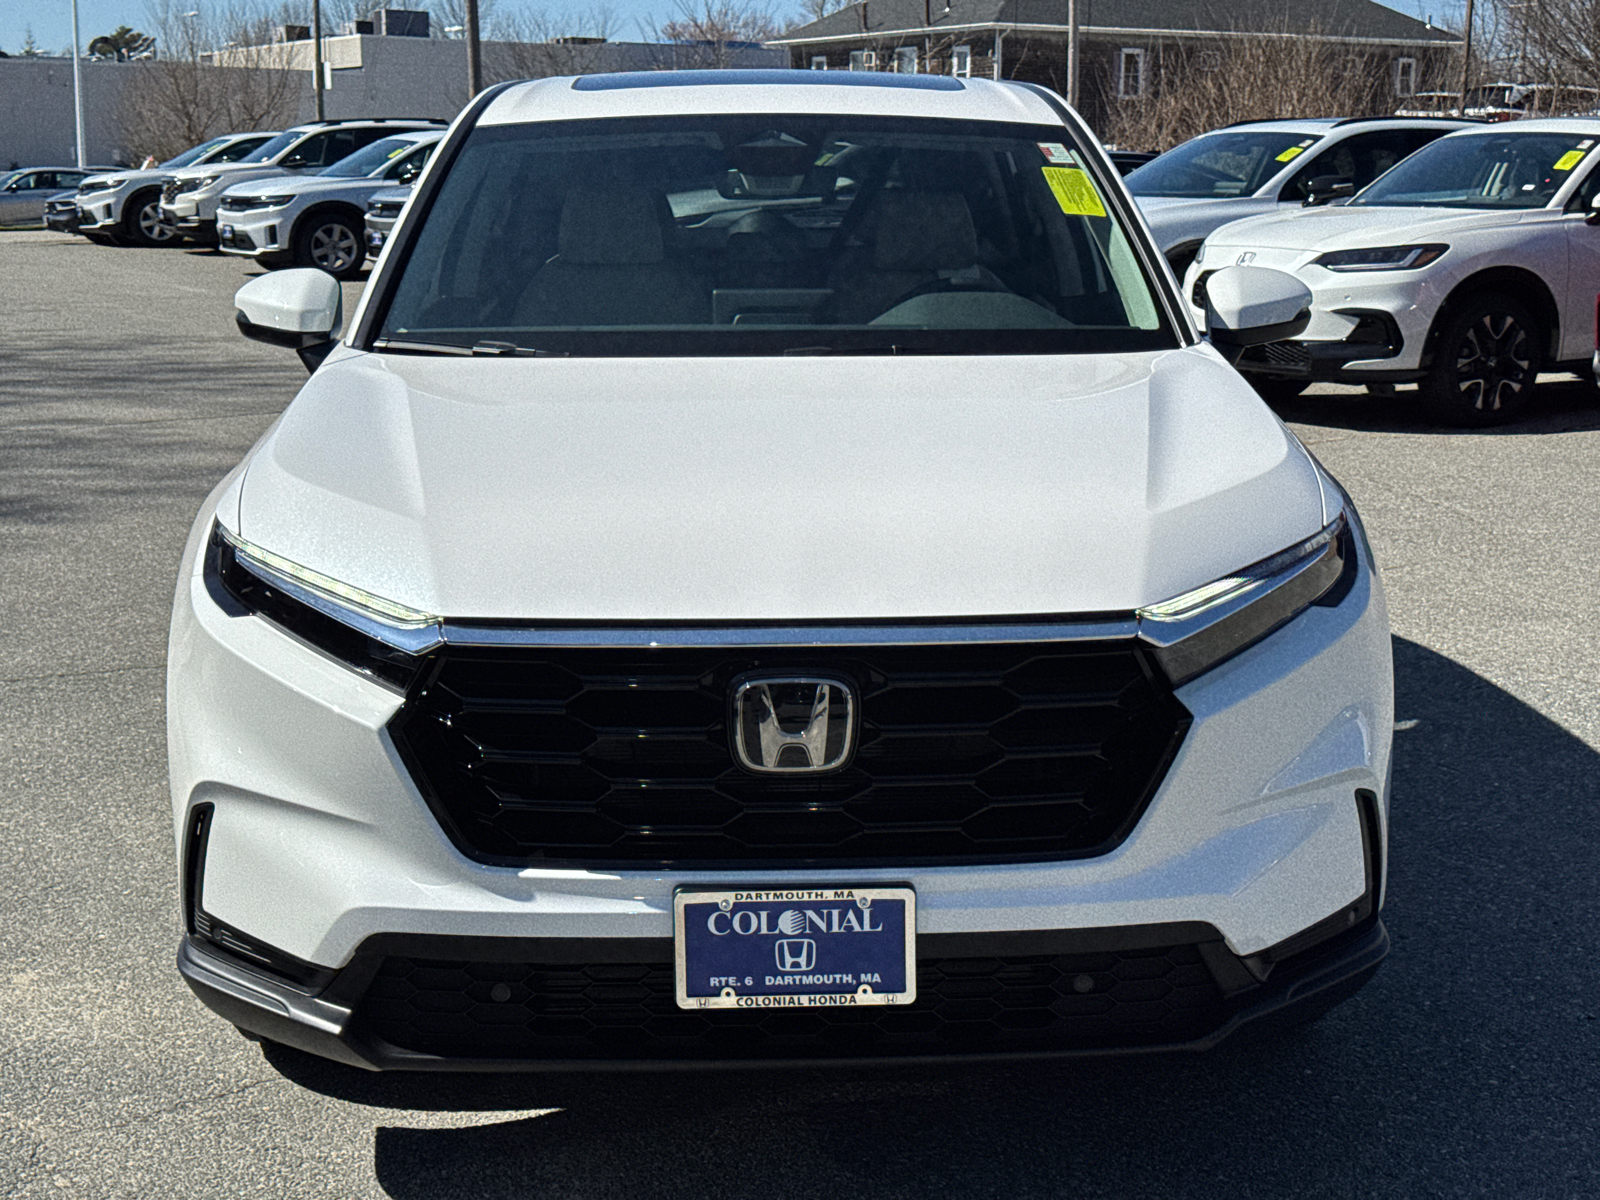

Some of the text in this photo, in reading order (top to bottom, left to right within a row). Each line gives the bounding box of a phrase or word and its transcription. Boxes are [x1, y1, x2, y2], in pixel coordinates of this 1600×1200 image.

[735, 891, 855, 901] DARTMOUTH, MA
[707, 908, 883, 936] COLONIAL
[710, 973, 882, 987] RTE. 6 DARTMOUTH, MA
[736, 995, 857, 1007] COLONIAL HONDA
